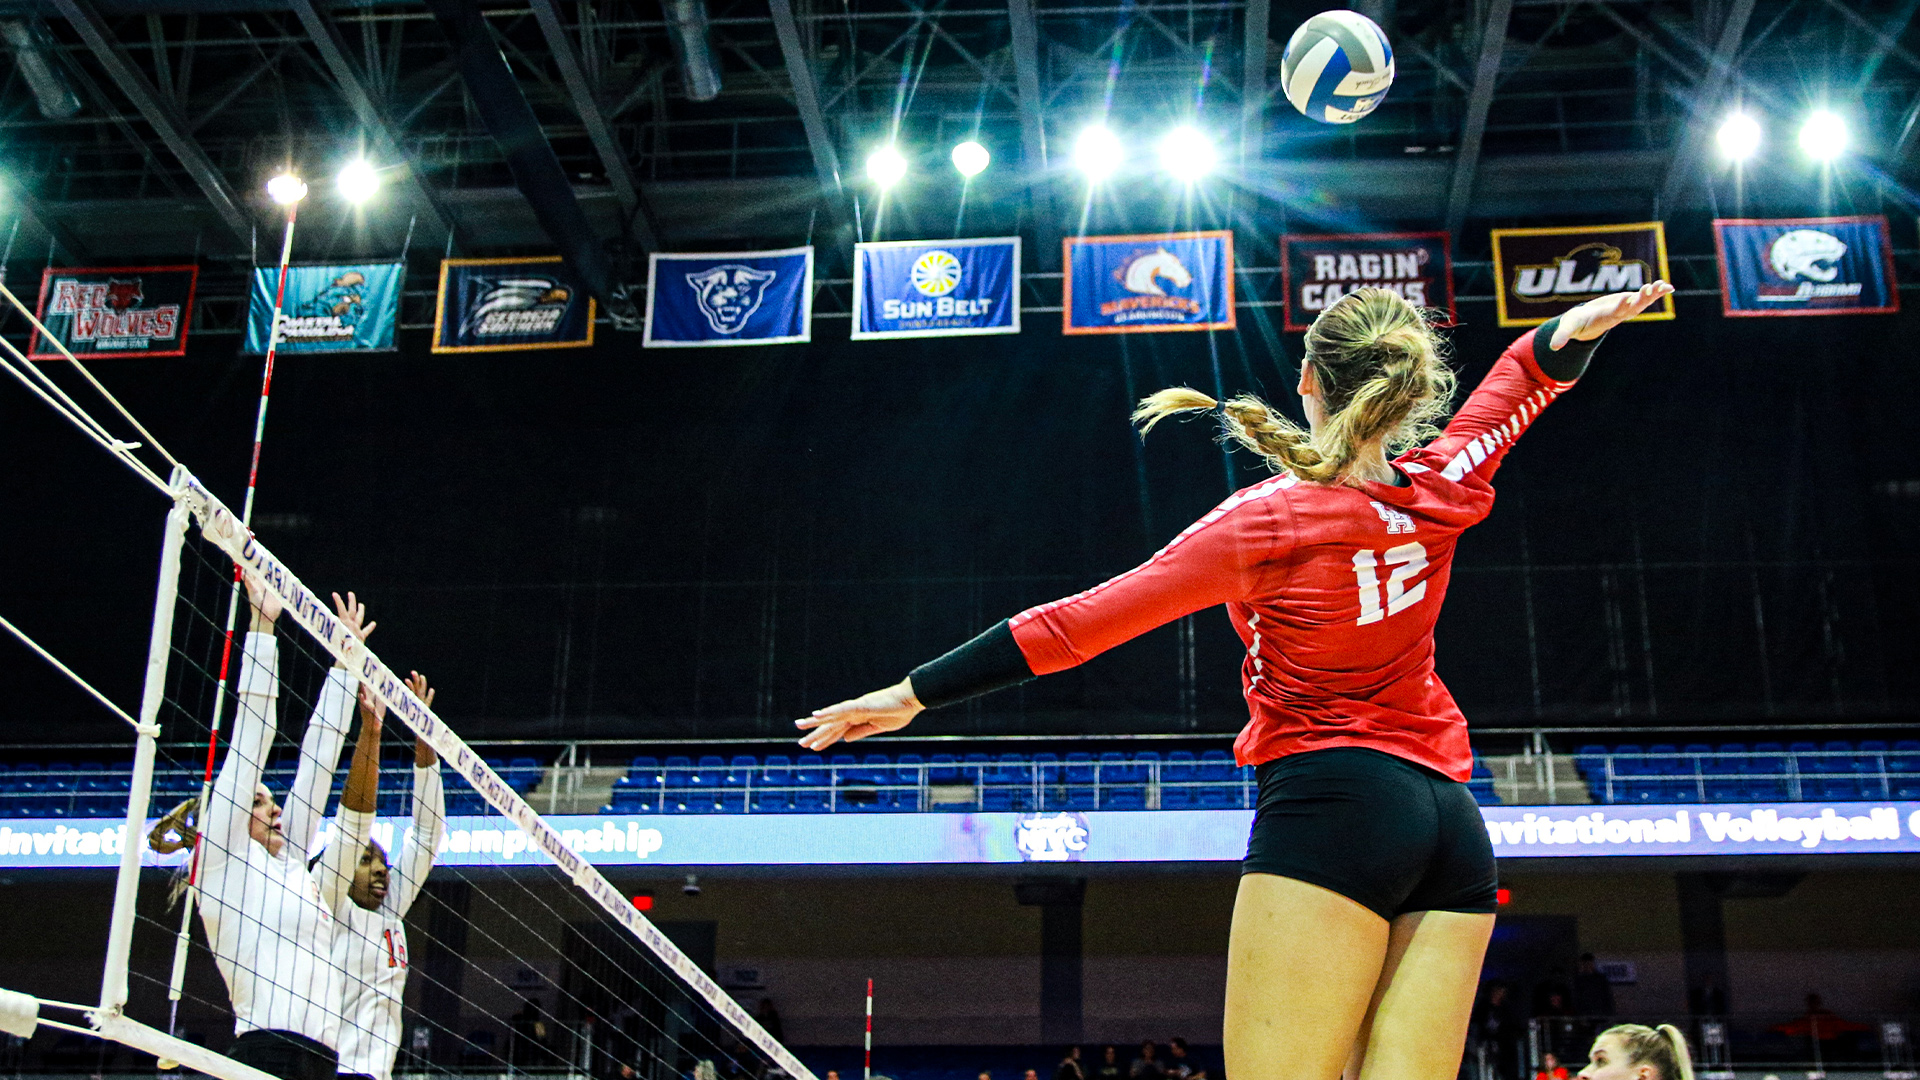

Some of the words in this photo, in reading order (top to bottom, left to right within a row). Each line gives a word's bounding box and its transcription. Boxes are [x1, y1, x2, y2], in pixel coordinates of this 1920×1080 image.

[1302, 281, 1427, 311] CAS
[1516, 260, 1643, 296] ULM
[72, 304, 179, 342] WOLVES
[883, 299, 932, 320] SUN
[936, 297, 993, 317] BELT
[1352, 541, 1430, 627] 12
[0, 824, 149, 856] Invitati
[403, 820, 663, 860] ampnship
[1485, 810, 1691, 845] nvitational
[1699, 807, 1900, 848] Volleyball
